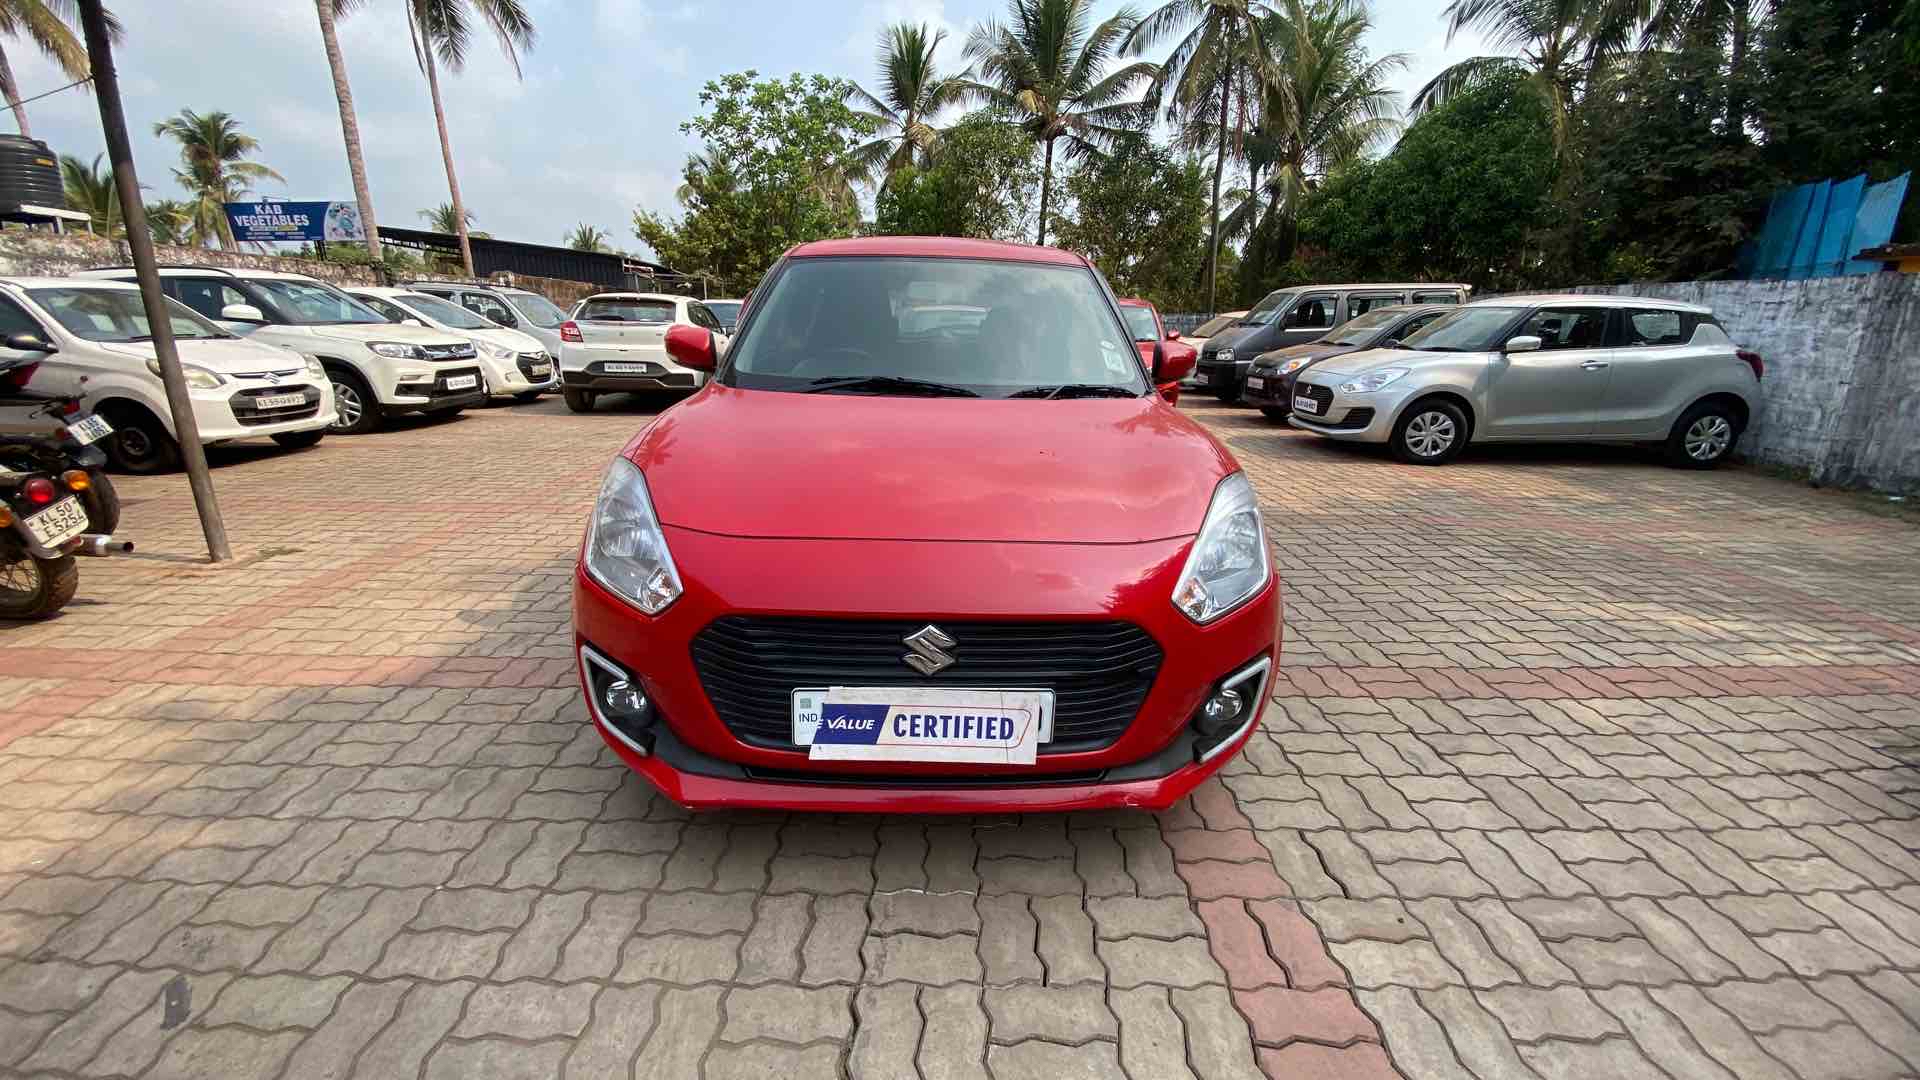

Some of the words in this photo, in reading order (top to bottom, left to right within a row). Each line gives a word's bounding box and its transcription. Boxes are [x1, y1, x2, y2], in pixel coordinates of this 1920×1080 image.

[234, 214, 310, 227] VEGETABLES
[39, 509, 58, 526] KL
[55, 502, 73, 516] 50
[799, 713, 818, 723] IND
[827, 714, 875, 730] VALUE
[893, 713, 1015, 740] CERTIFIED
